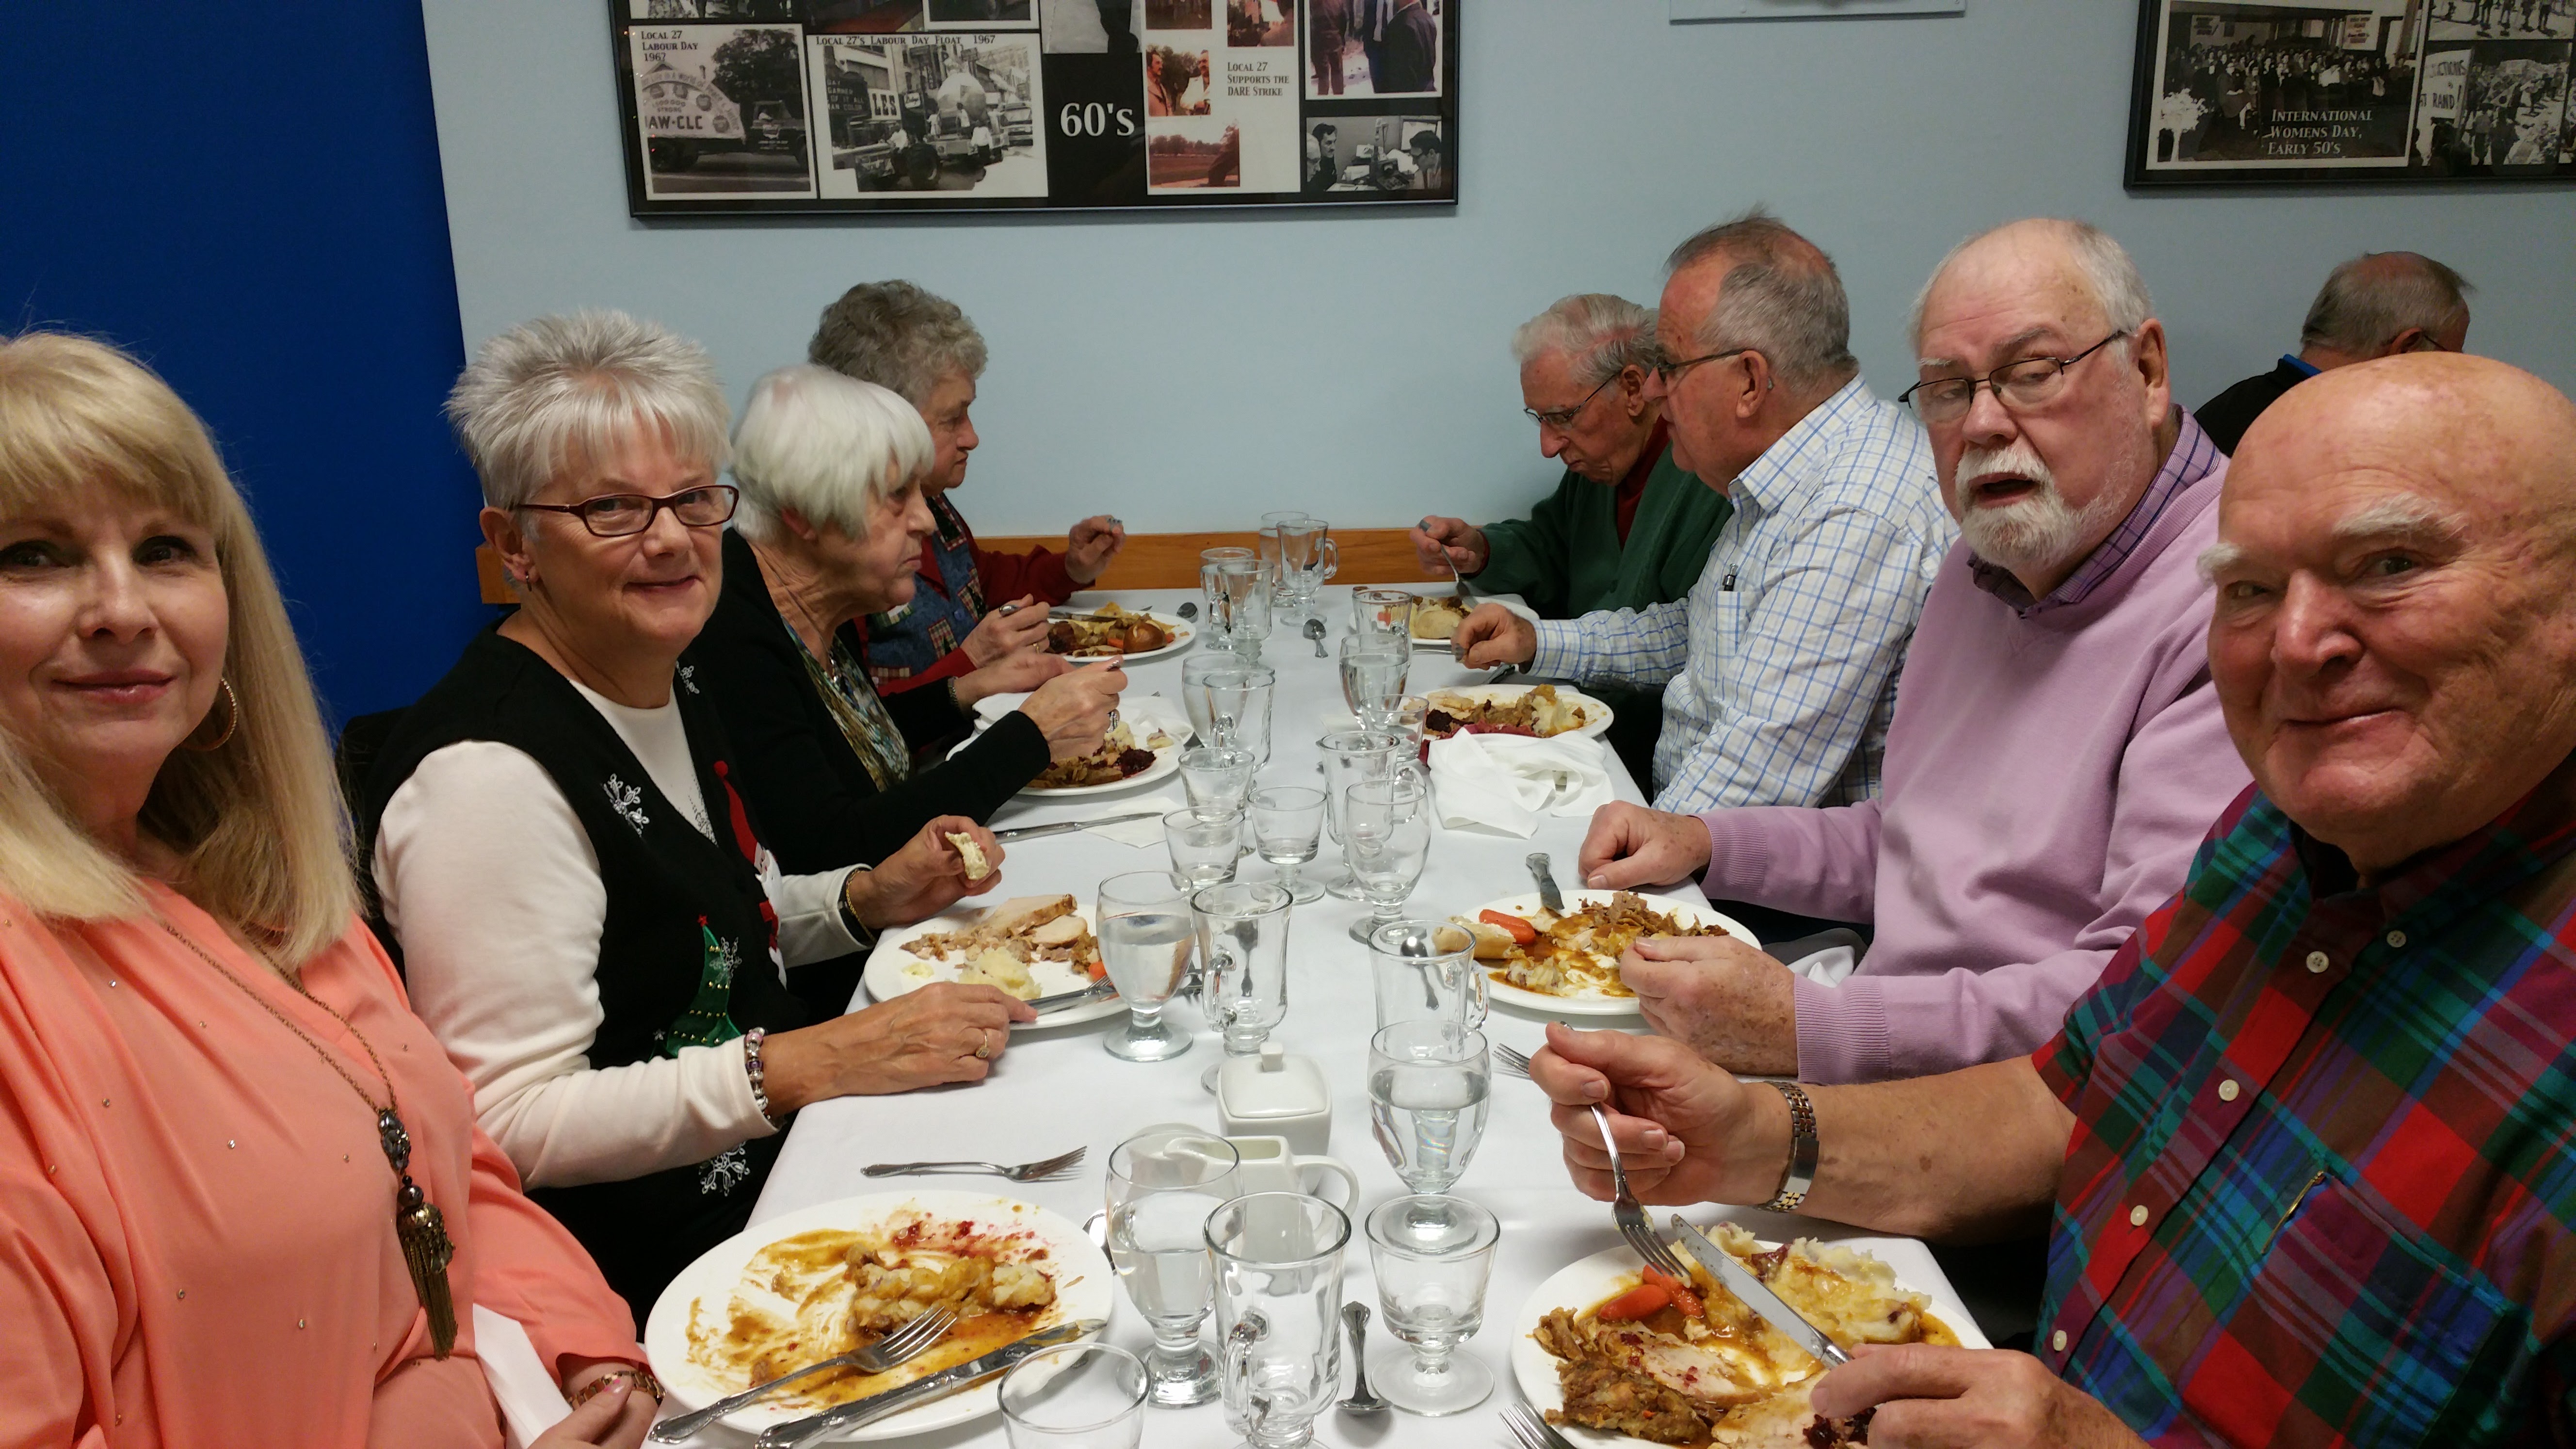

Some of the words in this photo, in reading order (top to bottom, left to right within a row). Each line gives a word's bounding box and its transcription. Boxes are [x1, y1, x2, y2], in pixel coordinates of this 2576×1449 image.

[671, 30, 682, 39] 27
[973, 35, 996, 44] 1967
[644, 52, 666, 62] 1967
[1256, 62, 1268, 72] 27
[1227, 86, 1250, 96] DARE
[2271, 109, 2372, 121] INTERNATIONAL
[2270, 125, 2328, 138] WOMENS
[2267, 142, 2309, 155] EARLY
